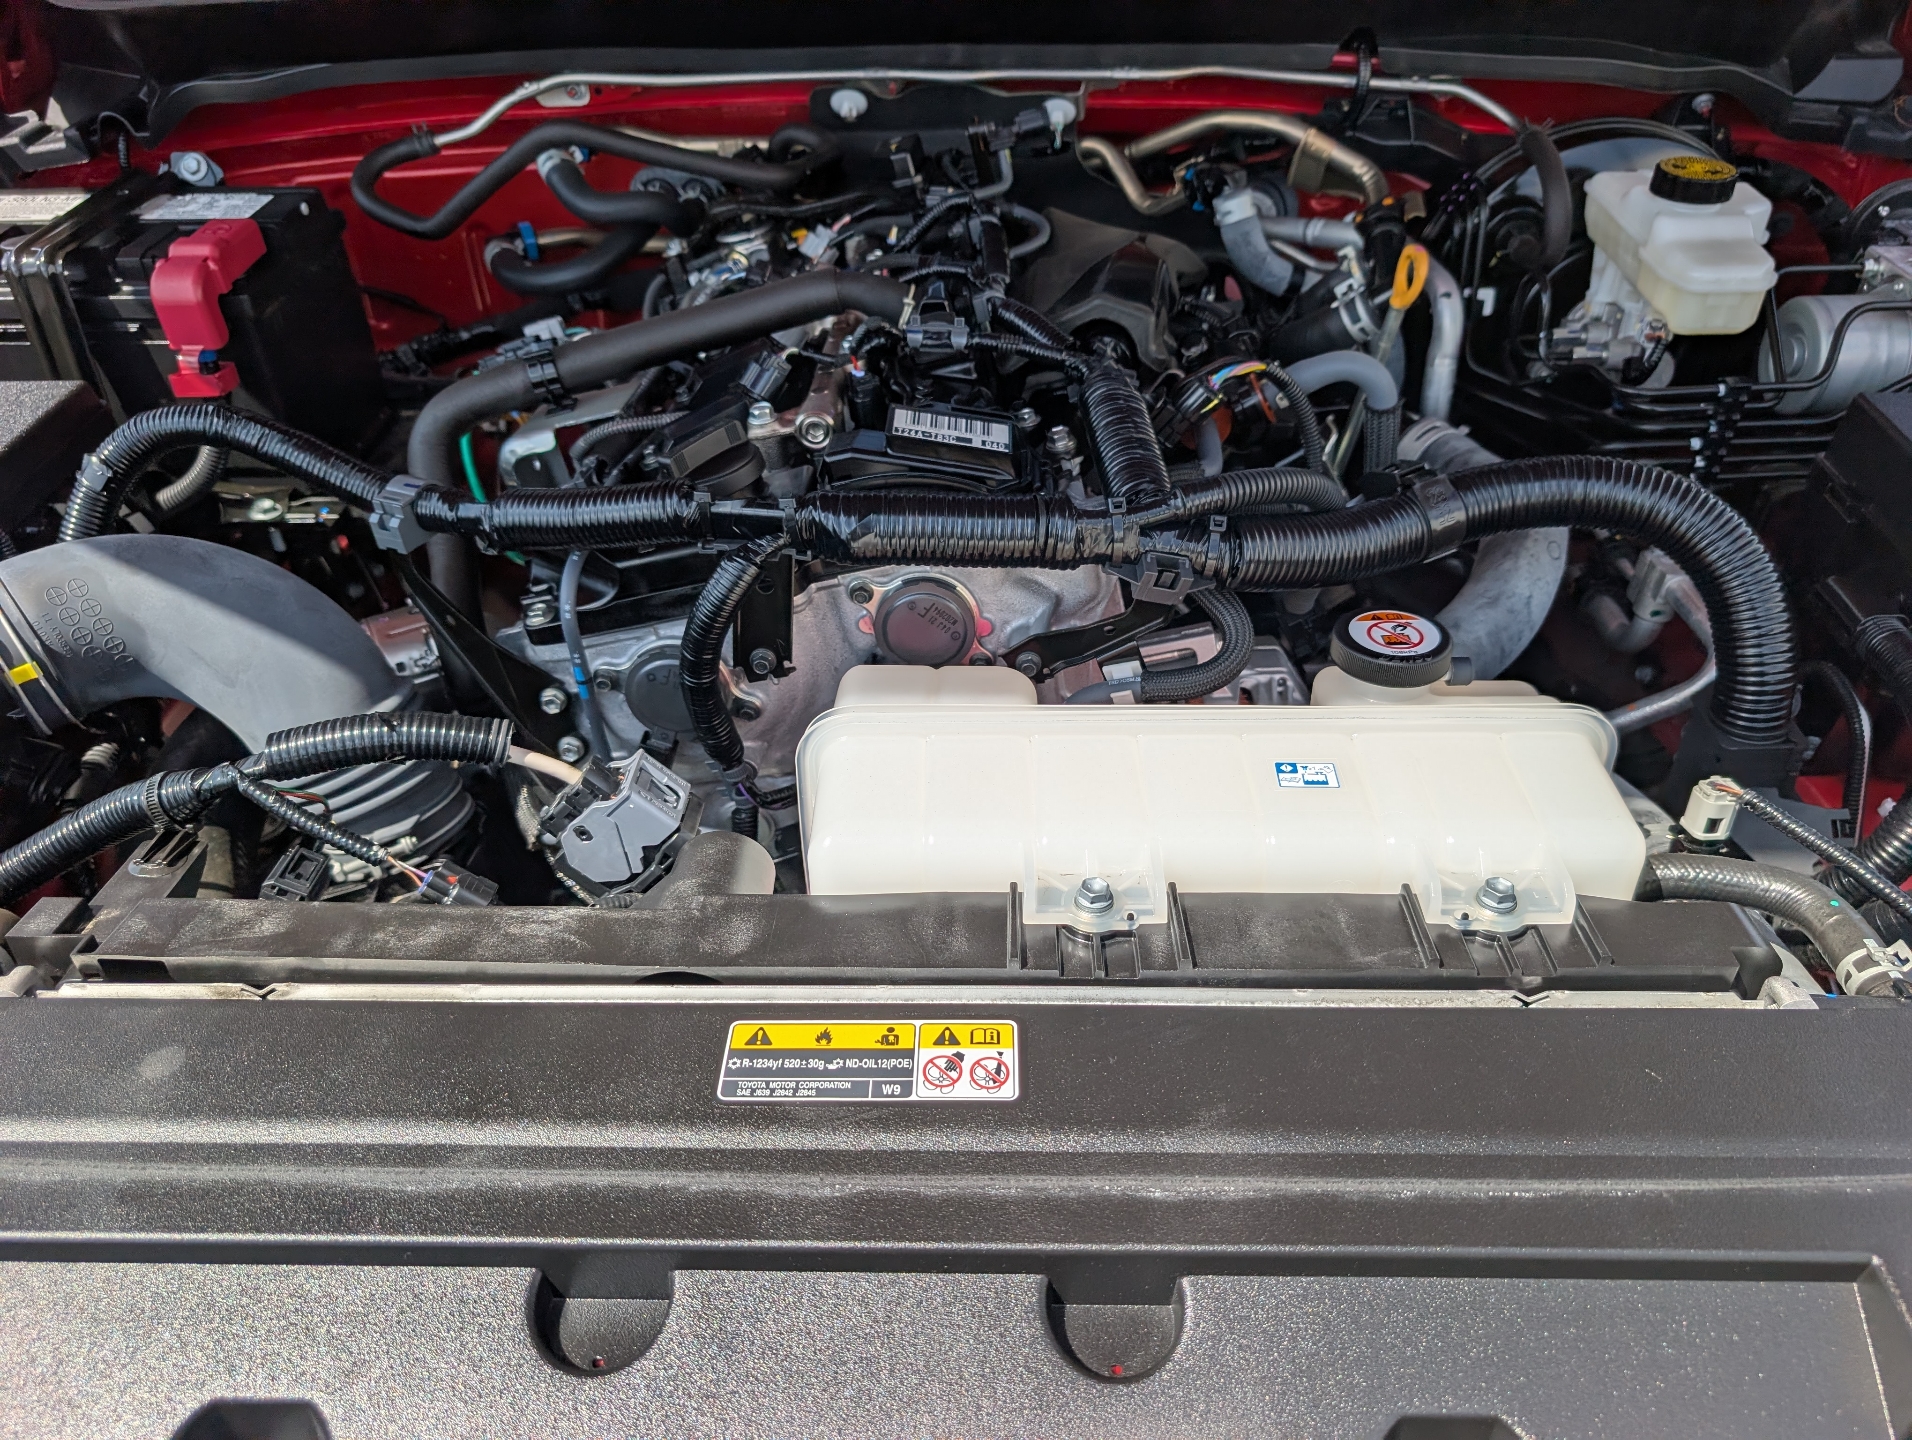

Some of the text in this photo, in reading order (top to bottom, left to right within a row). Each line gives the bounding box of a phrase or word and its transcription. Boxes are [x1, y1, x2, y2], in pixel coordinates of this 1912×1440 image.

[741, 1058, 913, 1071] R-1234yf 520±30g ND-OIL12(POE)
[737, 1081, 852, 1089] TOYOTA MOTOR CORPORATION
[881, 1084, 901, 1096] W9
